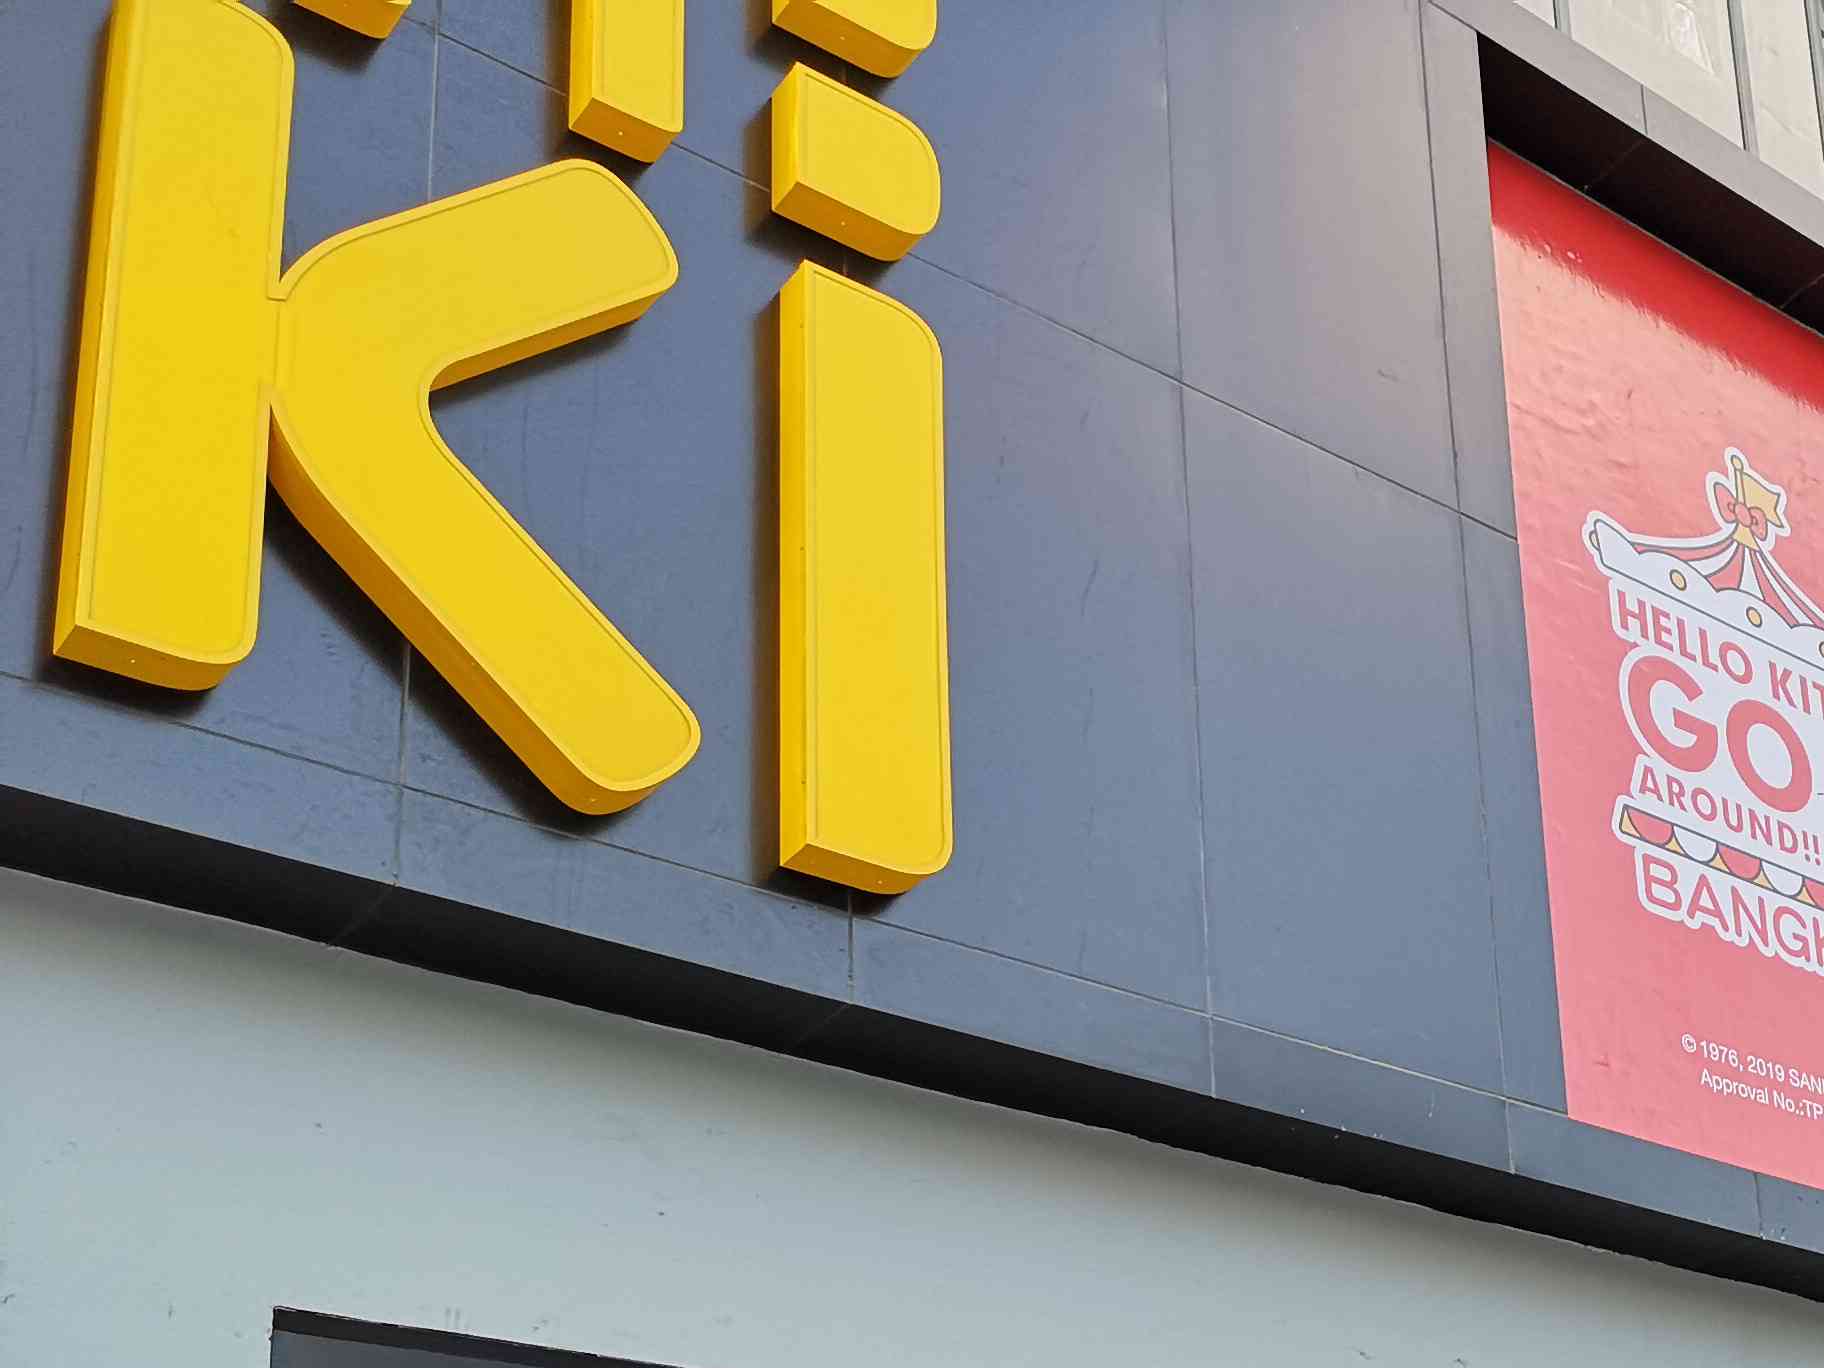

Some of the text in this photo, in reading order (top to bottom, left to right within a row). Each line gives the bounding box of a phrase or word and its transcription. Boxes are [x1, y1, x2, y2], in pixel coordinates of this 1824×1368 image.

[1617, 589, 1753, 684] HELLO
[1628, 655, 1812, 813] GO
[1639, 765, 1821, 867] AROUND!!
[1700, 1040, 1744, 1071] 1976,
[1747, 1055, 1785, 1082] 2019
[1700, 1069, 1769, 1105] Approval
